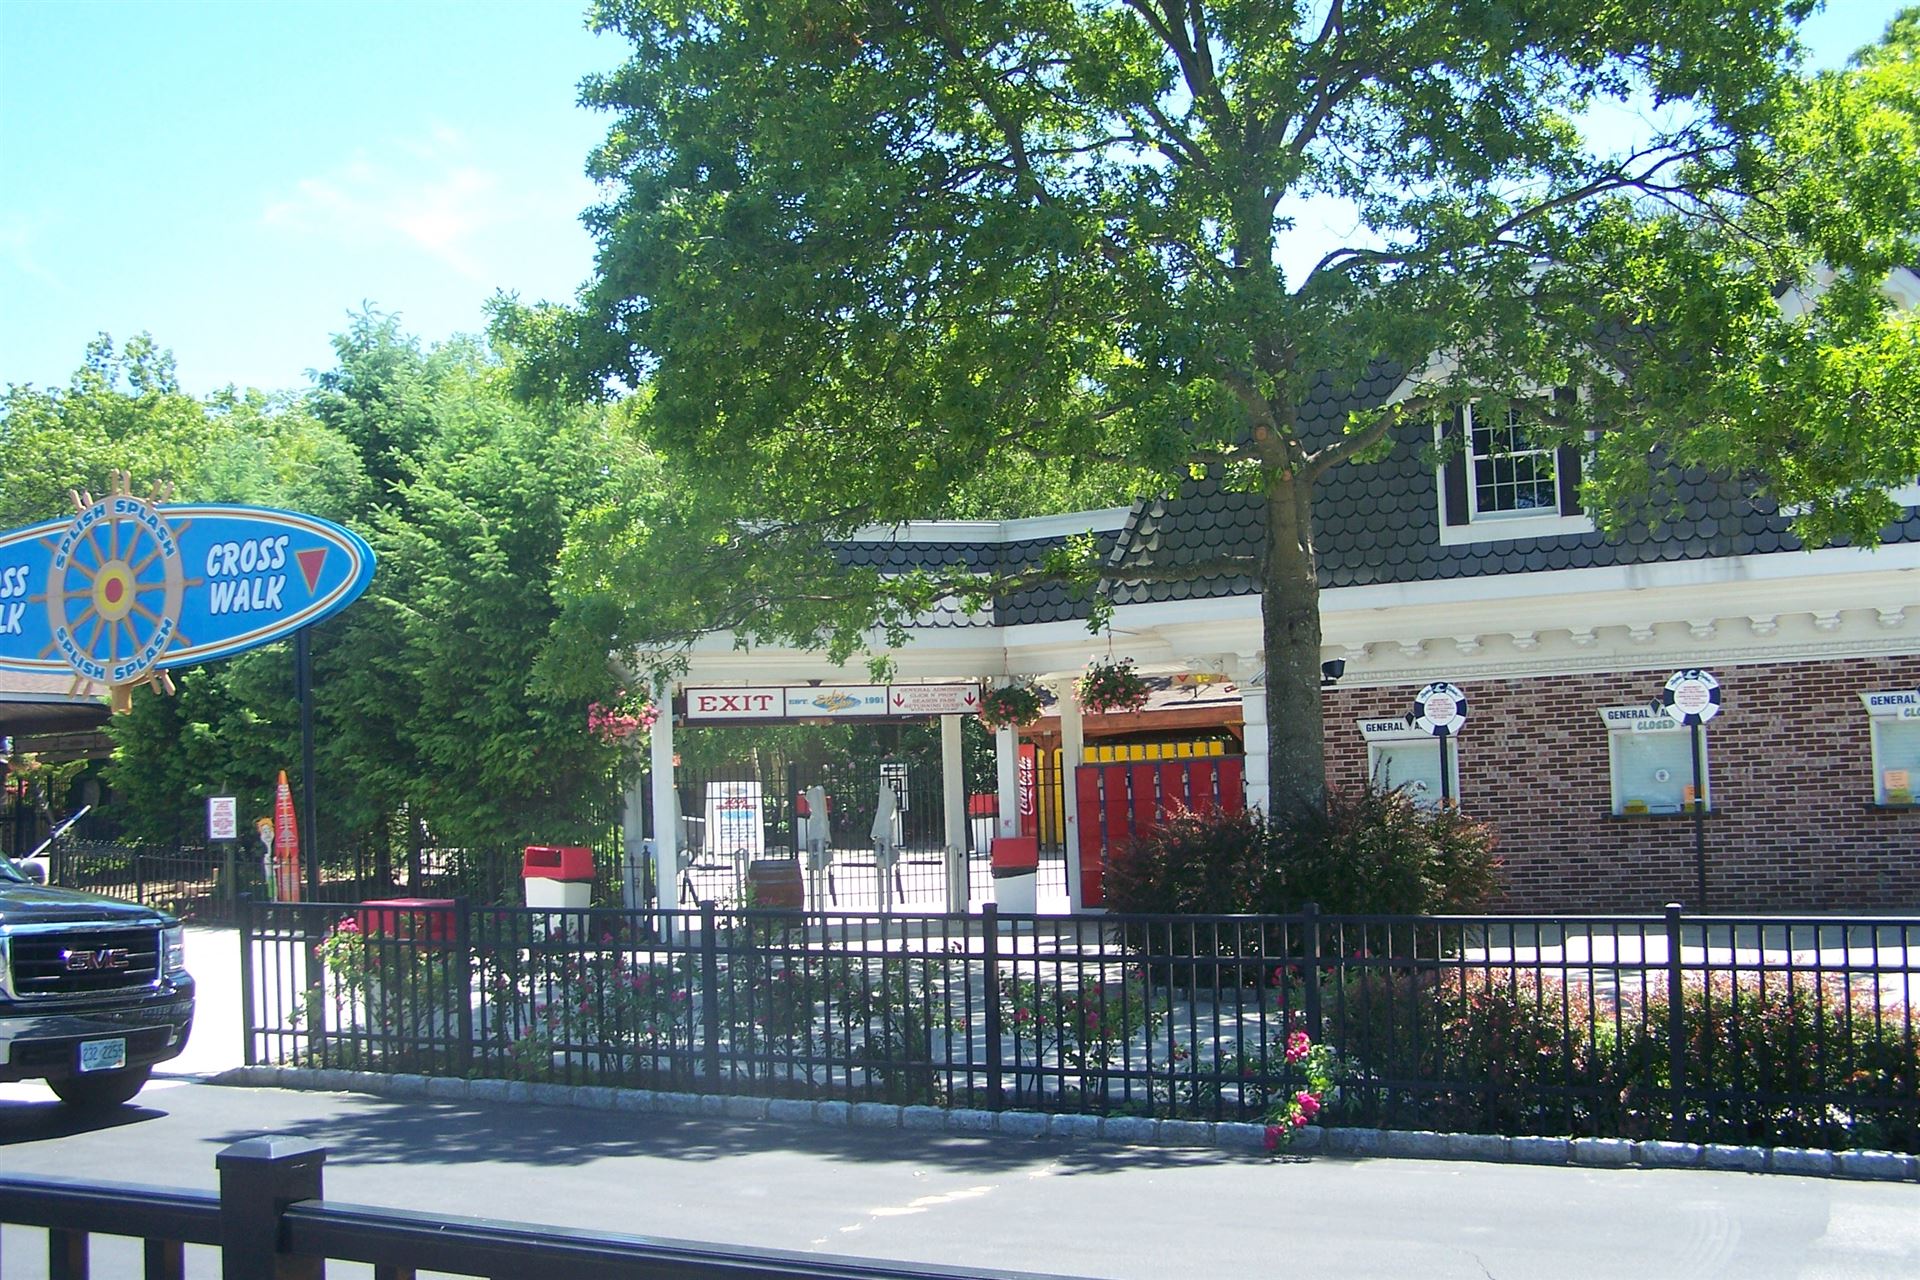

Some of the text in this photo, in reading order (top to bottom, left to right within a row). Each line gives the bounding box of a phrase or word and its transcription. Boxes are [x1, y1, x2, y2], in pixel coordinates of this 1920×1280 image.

[55, 498, 176, 570] SPLISH SPLASH
[207, 535, 290, 577] CROSS
[209, 574, 287, 616] WALK
[56, 617, 174, 681] SPLISH SPLASH
[697, 694, 774, 712] EXIT
[864, 697, 885, 705] 1991
[1871, 694, 1917, 706] GENERAL
[1607, 709, 1650, 720] GENERAL
[1365, 722, 1405, 733] GENERAL
[1637, 719, 1676, 730] CLOSED
[65, 948, 129, 971] GMC
